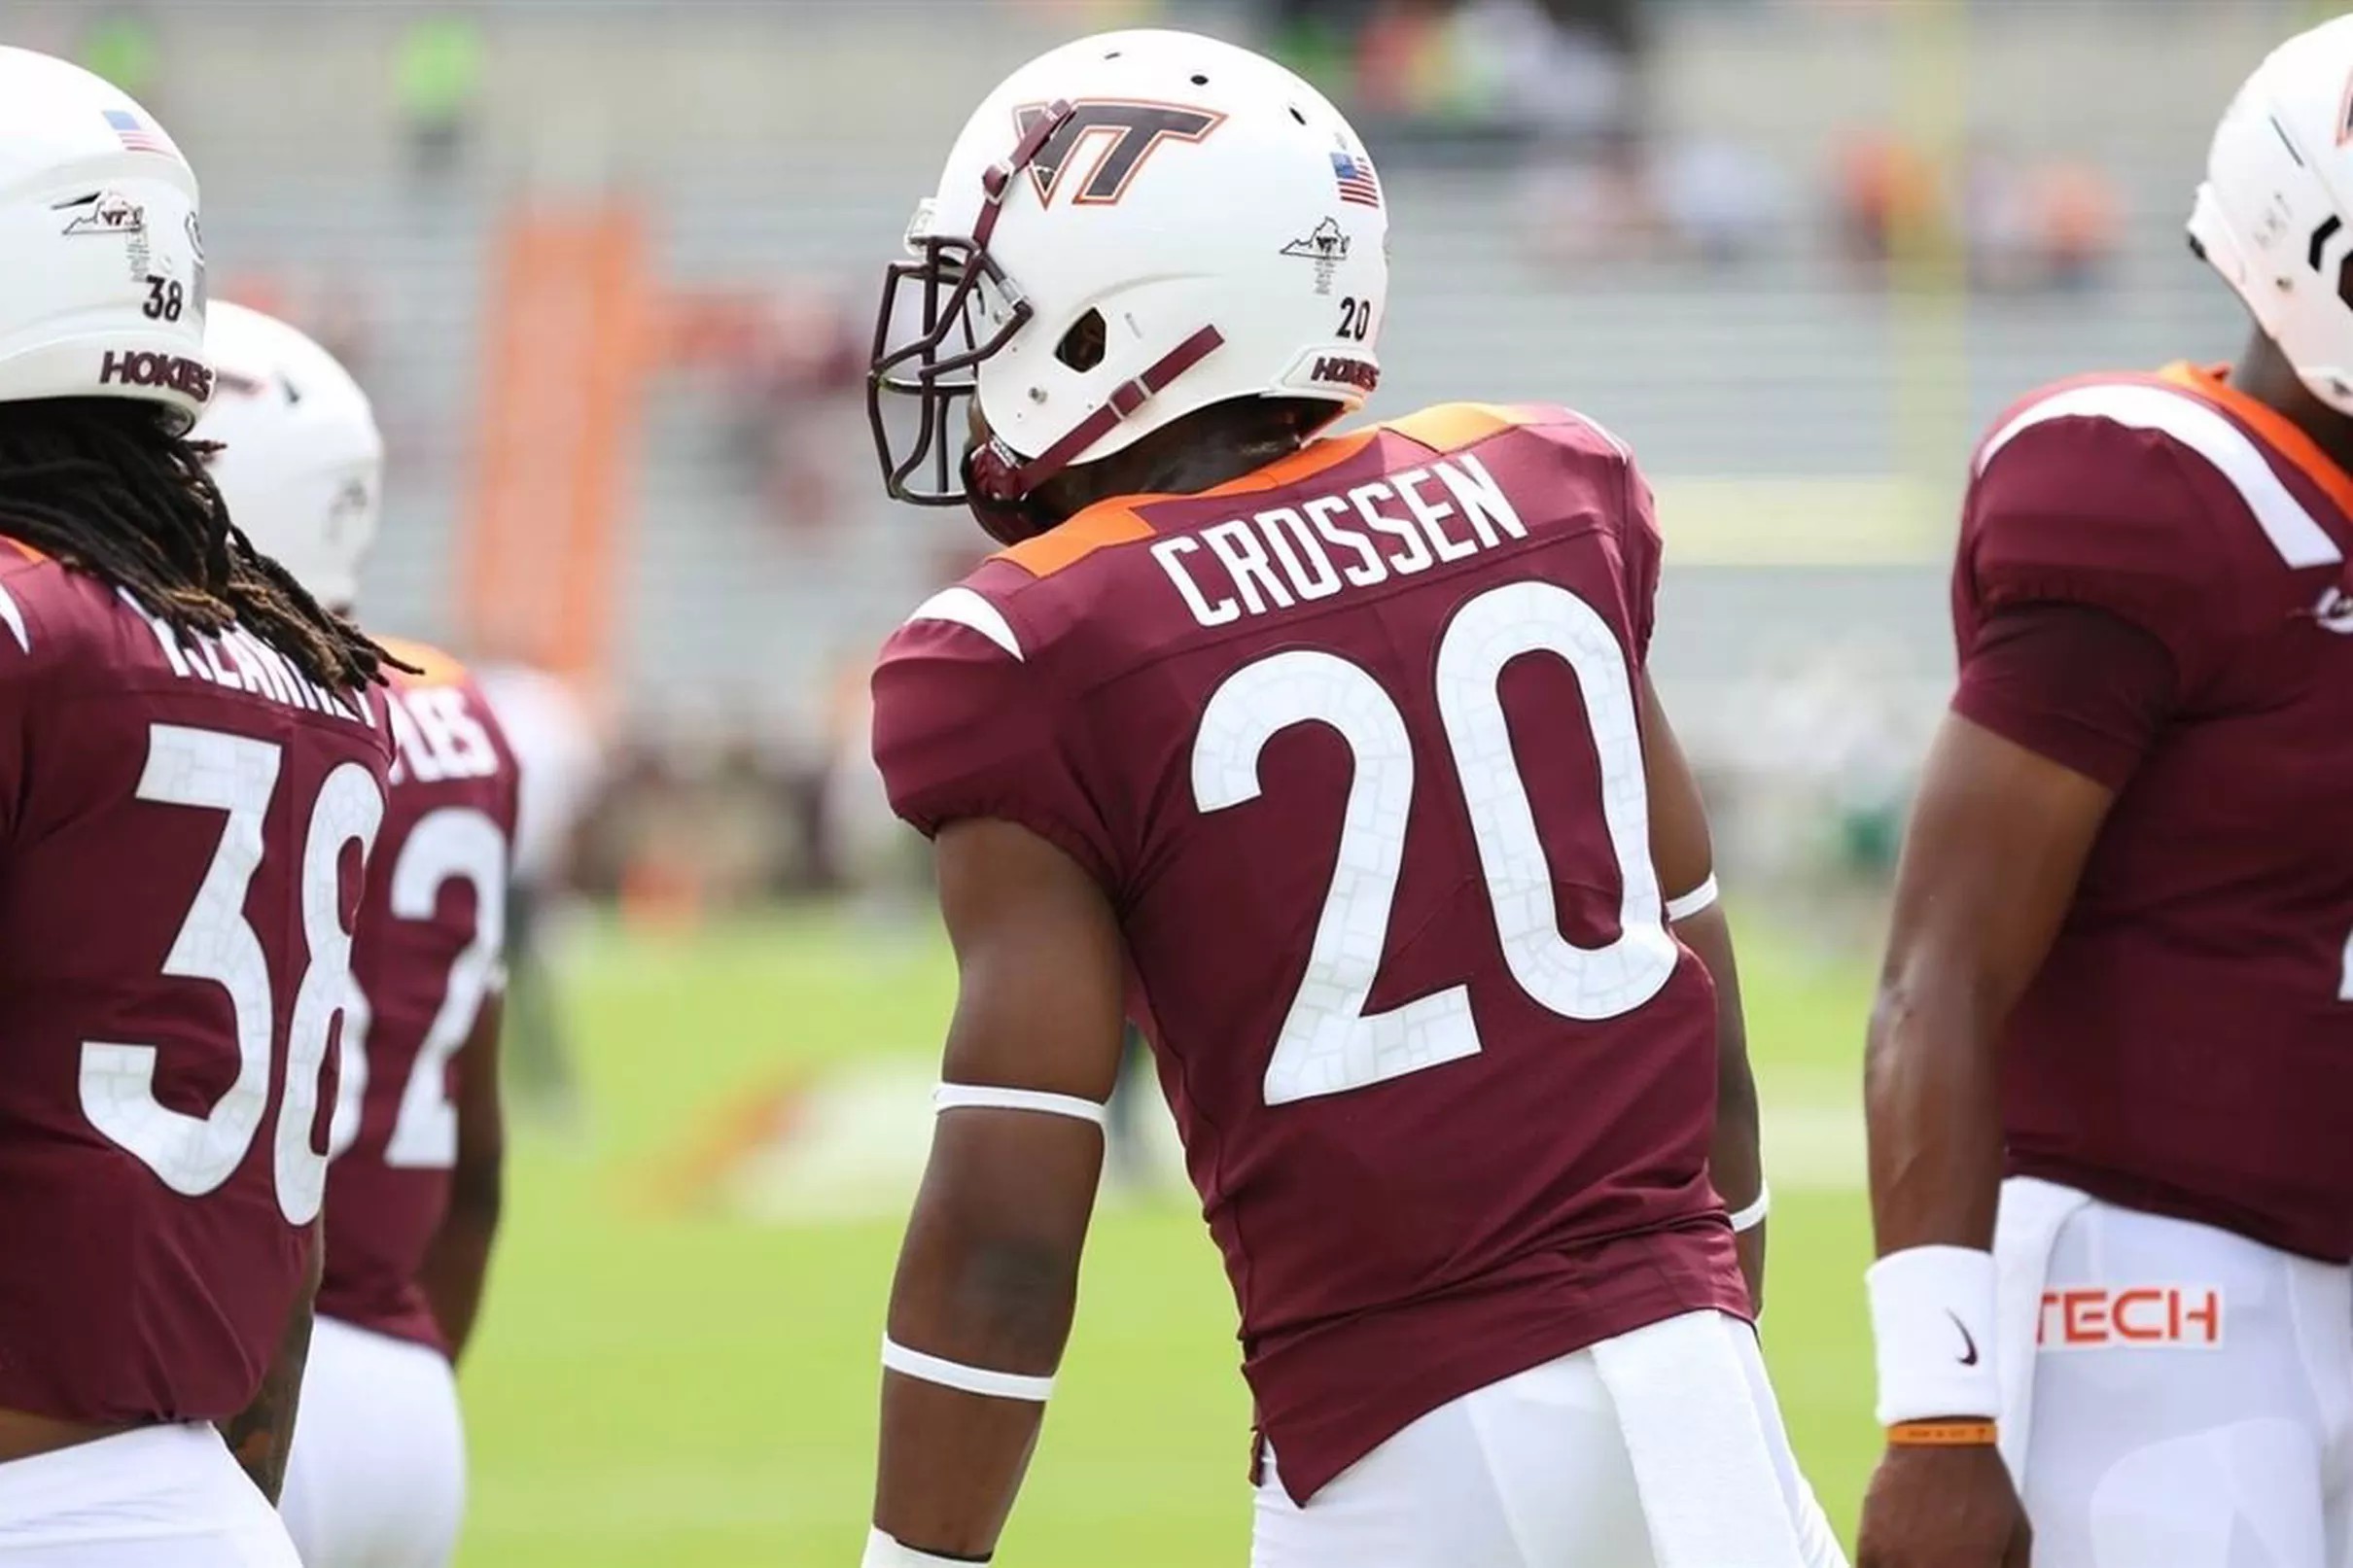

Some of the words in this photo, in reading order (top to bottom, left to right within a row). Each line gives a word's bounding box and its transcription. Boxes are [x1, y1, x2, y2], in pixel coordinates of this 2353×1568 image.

[143, 273, 183, 323] 38
[1335, 296, 1371, 342] 20
[99, 351, 212, 402] HOKIES
[1150, 453, 1528, 627] CROSSEN
[1191, 581, 1678, 1106] 20
[78, 723, 385, 1226] 38
